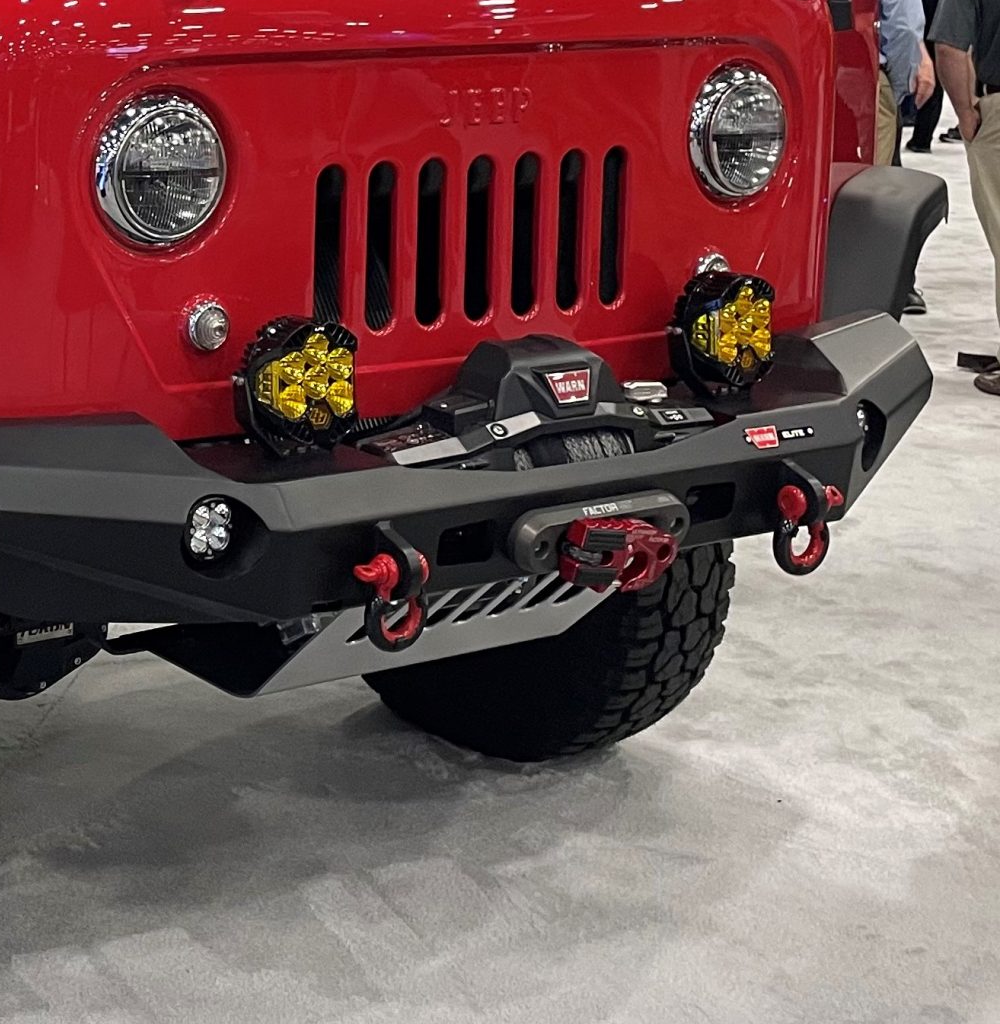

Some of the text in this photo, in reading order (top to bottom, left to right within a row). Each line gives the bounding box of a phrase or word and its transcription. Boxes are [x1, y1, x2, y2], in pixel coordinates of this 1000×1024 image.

[438, 87, 532, 126] JEEP
[555, 380, 586, 395] WARN
[582, 502, 618, 516] FACTOR
